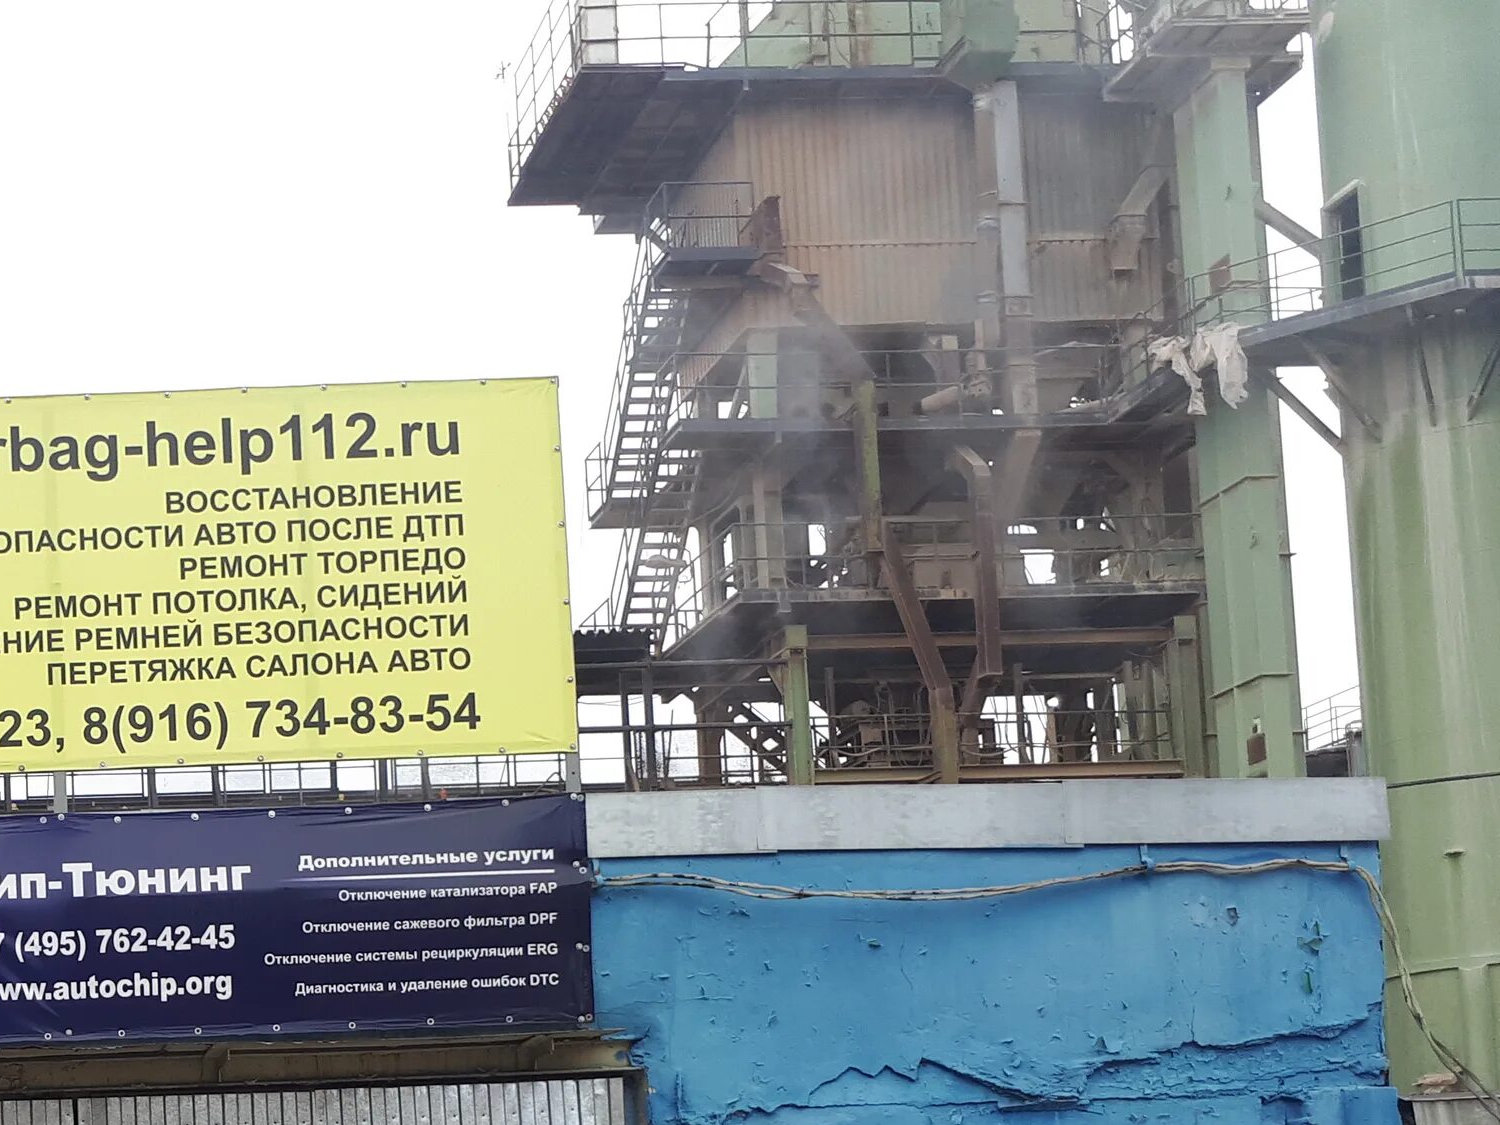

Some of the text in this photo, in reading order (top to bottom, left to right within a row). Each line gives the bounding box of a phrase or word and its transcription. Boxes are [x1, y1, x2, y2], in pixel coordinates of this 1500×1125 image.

[166, 481, 462, 513] ВОССТАНОВЛЕНИЕ
[194, 521, 276, 546] АВТО
[287, 517, 393, 542] ПОСЛЕ
[403, 514, 463, 542] ДТП
[180, 547, 465, 580] РЕМОНТ ТОРПЕДО
[15, 575, 467, 619] РЕМОНТ ПОТОЛКА, СИДЕНИЙ
[76, 617, 201, 650] РЕМНЕЙ
[214, 614, 468, 645] БЕЗОПАСНОСТИ
[48, 648, 470, 685] ПЕРЕТЯЖКА САЛОНА АВТО
[84, 702, 227, 753] 8(916)
[246, 692, 480, 737] 734-83-54
[297, 848, 554, 872] Дополнительные услуги
[338, 881, 558, 902] Отключение катализатора FAP
[302, 912, 558, 934] Отключение сажевого фильтра DPF
[15, 931, 85, 962] (495)
[96, 925, 235, 953] 762-42-45
[264, 942, 559, 966] Отключение системы рециркуляции ERG
[294, 973, 560, 997] Диагностика и удаление ошибок DTC
